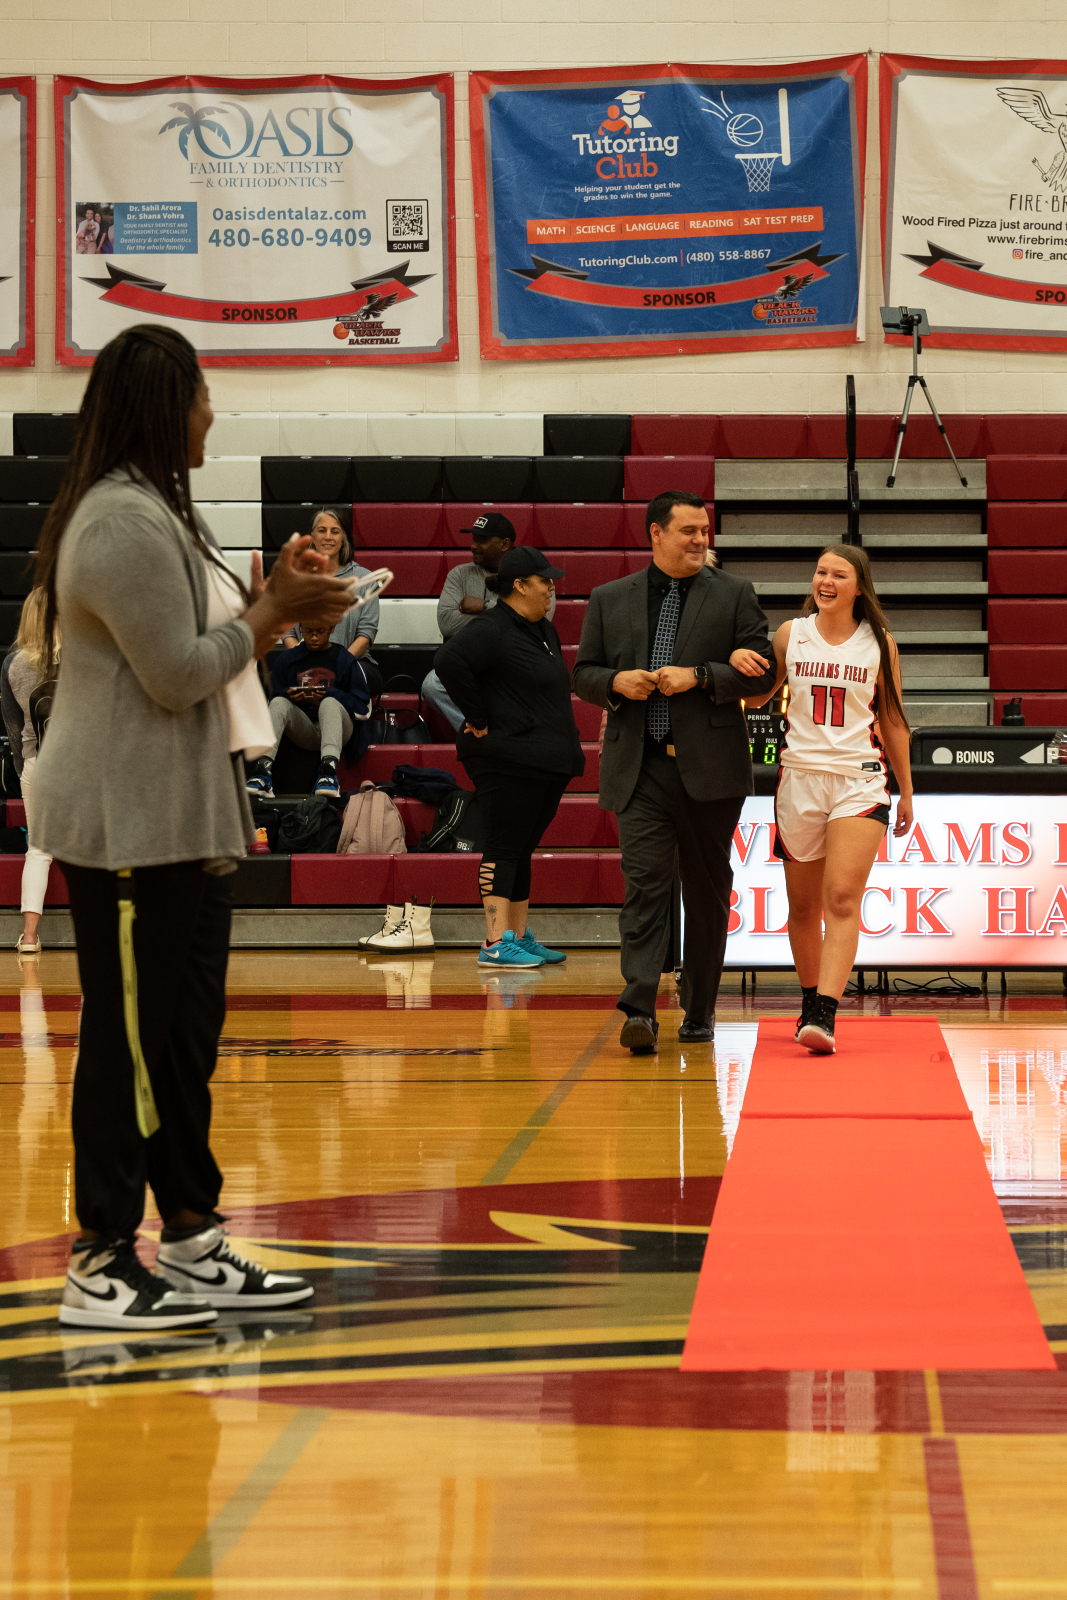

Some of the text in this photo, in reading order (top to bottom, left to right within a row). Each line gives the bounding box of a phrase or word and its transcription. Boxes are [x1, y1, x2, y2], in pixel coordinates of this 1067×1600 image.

[193, 101, 354, 160] OASIS
[572, 131, 679, 157] Tutoring
[190, 161, 344, 174] FAMILY DENTISTRY
[596, 153, 658, 179] Club
[206, 177, 327, 188] & ORTHODONTICS
[574, 186, 603, 194] Helping
[605, 185, 622, 193] your
[583, 194, 608, 203] grades
[649, 191, 673, 199] game.
[1009, 193, 1043, 212] FIRE
[212, 207, 367, 221] Oasisdentalaz.com
[536, 214, 814, 235] MATH SCIENCE LANGUAGE READING SAT TEST PREP
[902, 215, 934, 226] Wood
[937, 216, 965, 227] Fired
[968, 218, 997, 228] Pizza
[999, 219, 1020, 231] just
[1023, 221, 1062, 231] around
[208, 227, 372, 248] 480-680-9409
[413, 242, 424, 250] ME
[578, 249, 771, 268] TutoringClub.com (480) 558-8867
[643, 291, 716, 307] SPONSOR
[221, 307, 298, 321] SPONSOR
[766, 316, 817, 325] BASKETBALL
[795, 661, 868, 684] WILLIAMS FIELD
[811, 684, 847, 727] 11
[764, 744, 776, 764] 0
[956, 750, 995, 764] BONUS
[727, 886, 952, 936] LCK
